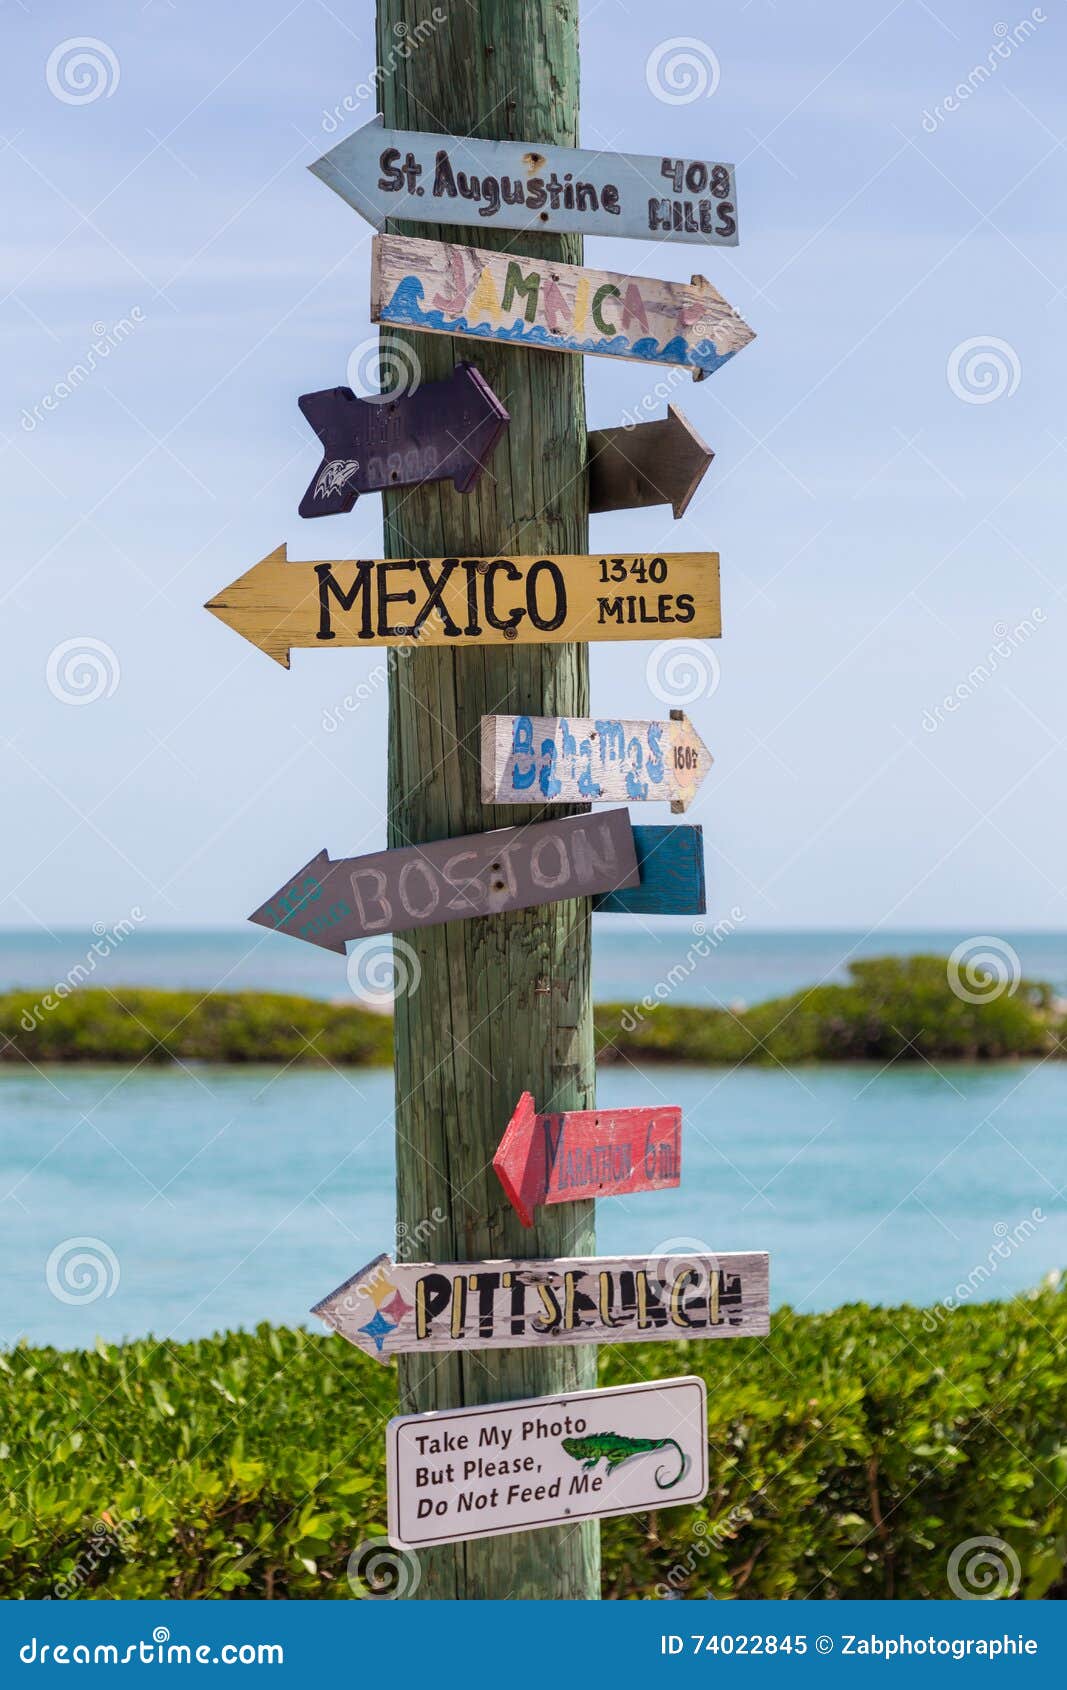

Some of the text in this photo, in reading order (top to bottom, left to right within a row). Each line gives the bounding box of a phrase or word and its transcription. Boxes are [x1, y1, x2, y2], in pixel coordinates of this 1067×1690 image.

[378, 147, 621, 217] St. Augustine
[661, 157, 730, 199] 408
[648, 198, 736, 237] MILES
[431, 251, 649, 336] JAMAICA
[599, 557, 668, 584] 1340
[313, 559, 568, 640] MEXICO
[597, 593, 696, 624] MILES
[350, 824, 616, 931] BOSTON
[416, 1416, 587, 1456] Take My Photo
[416, 1455, 542, 1487] But Please,
[417, 1474, 603, 1518] Do Not Feed Me
